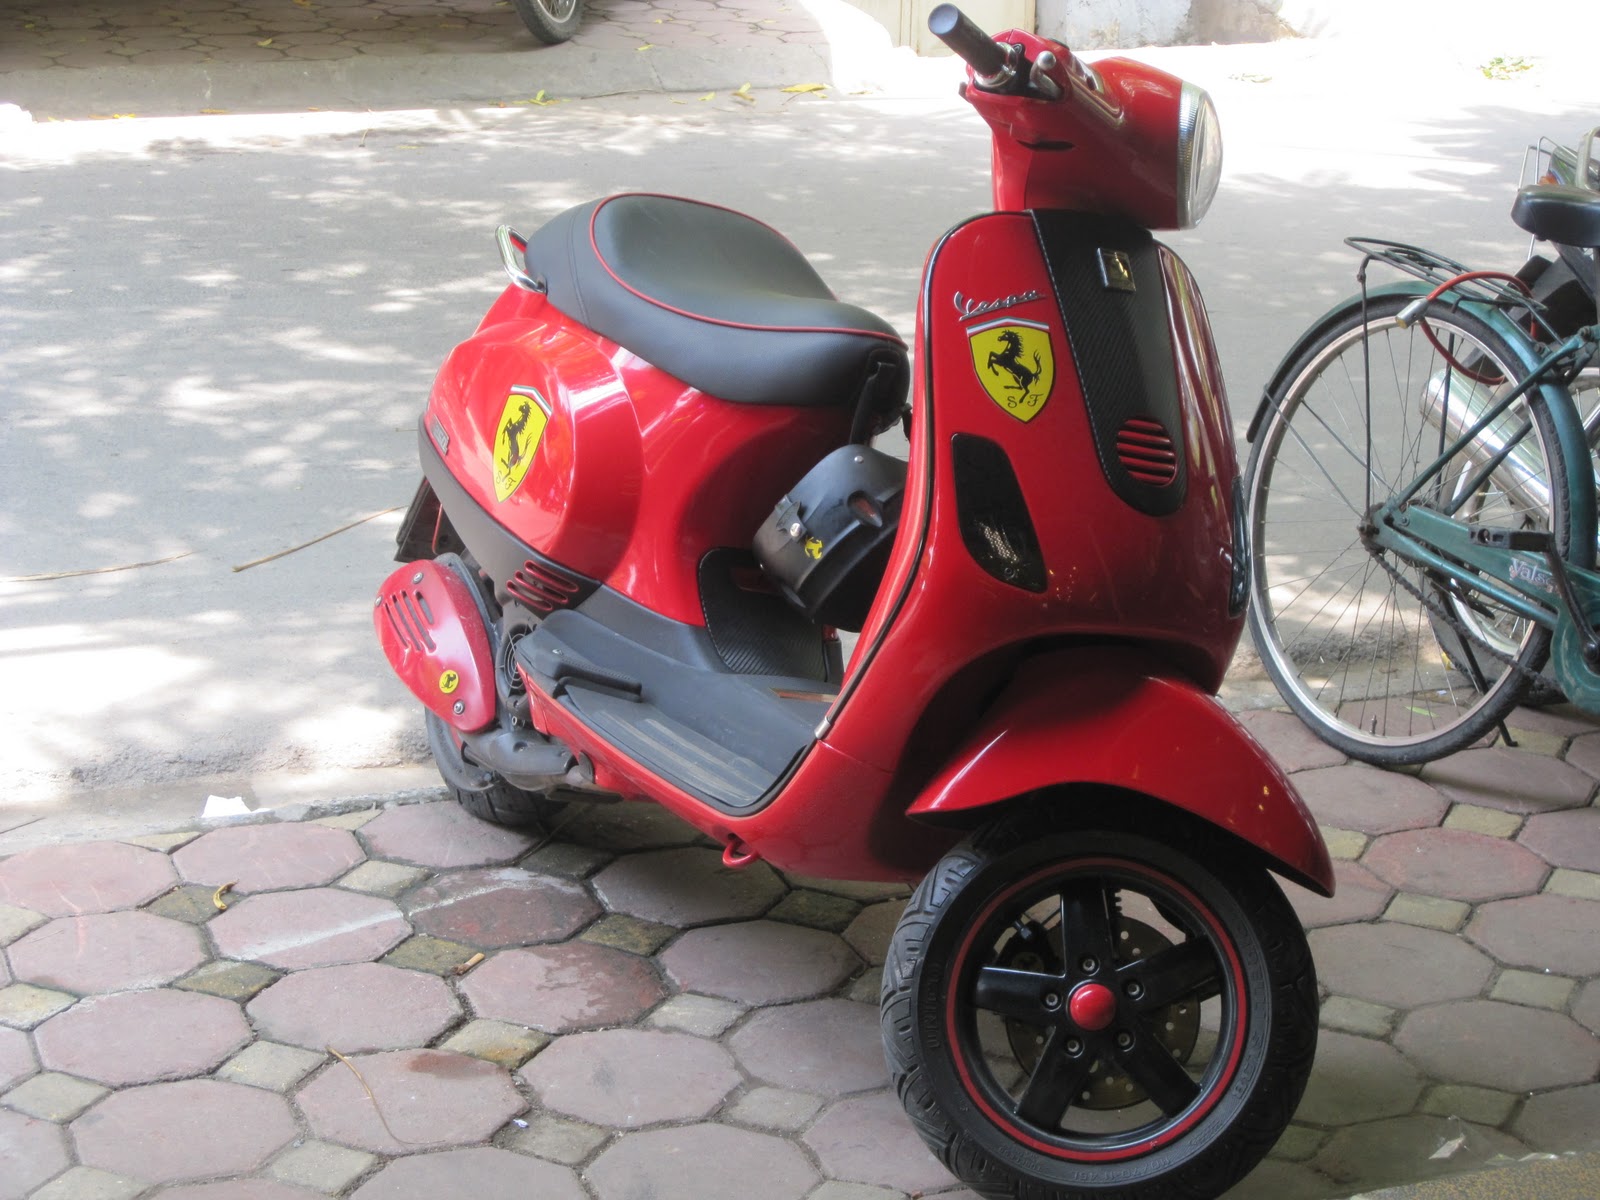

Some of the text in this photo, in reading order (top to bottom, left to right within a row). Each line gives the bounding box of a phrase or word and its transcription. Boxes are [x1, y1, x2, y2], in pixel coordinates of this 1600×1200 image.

[953, 290, 1050, 321] Vespa
[1007, 393, 1044, 409] S F
